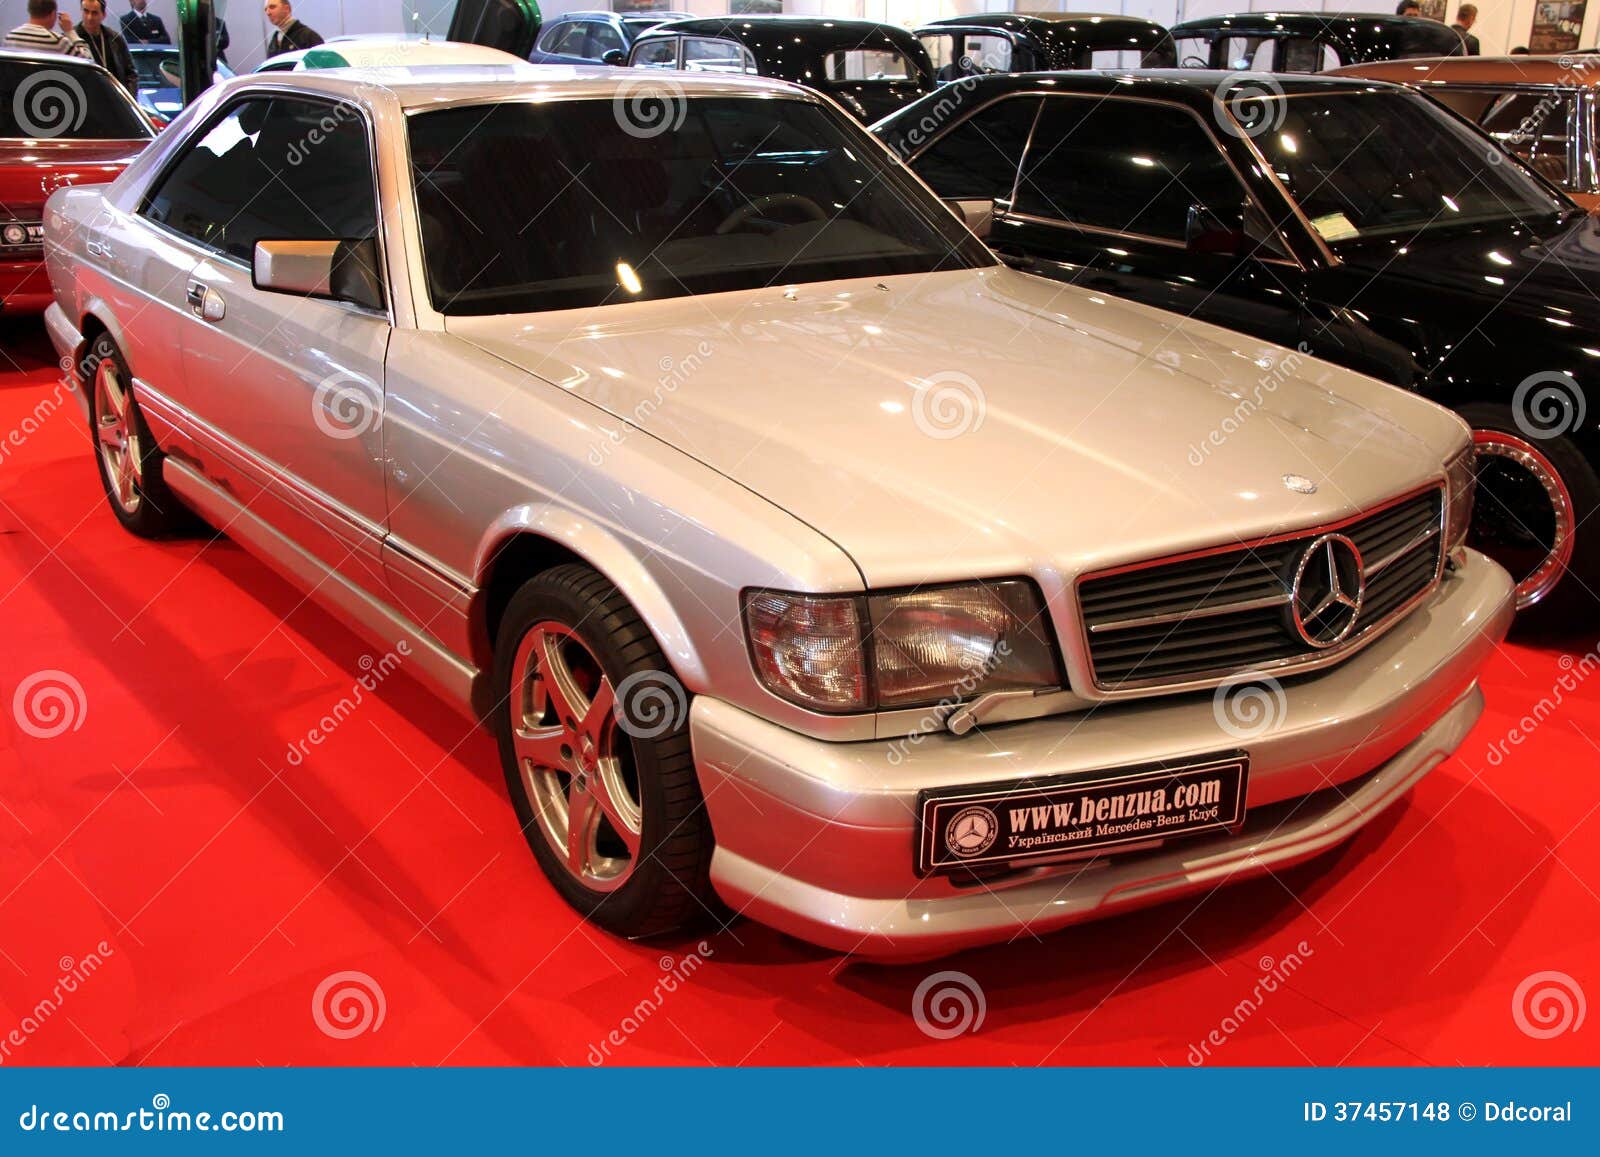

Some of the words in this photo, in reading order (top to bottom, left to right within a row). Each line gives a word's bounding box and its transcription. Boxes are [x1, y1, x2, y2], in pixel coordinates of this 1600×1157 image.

[1008, 827, 1093, 848] Український
[1095, 814, 1186, 836] Mercedes-Benz
[1189, 806, 1219, 822] Клуб
[1009, 779, 1221, 833] www.benzua.com
